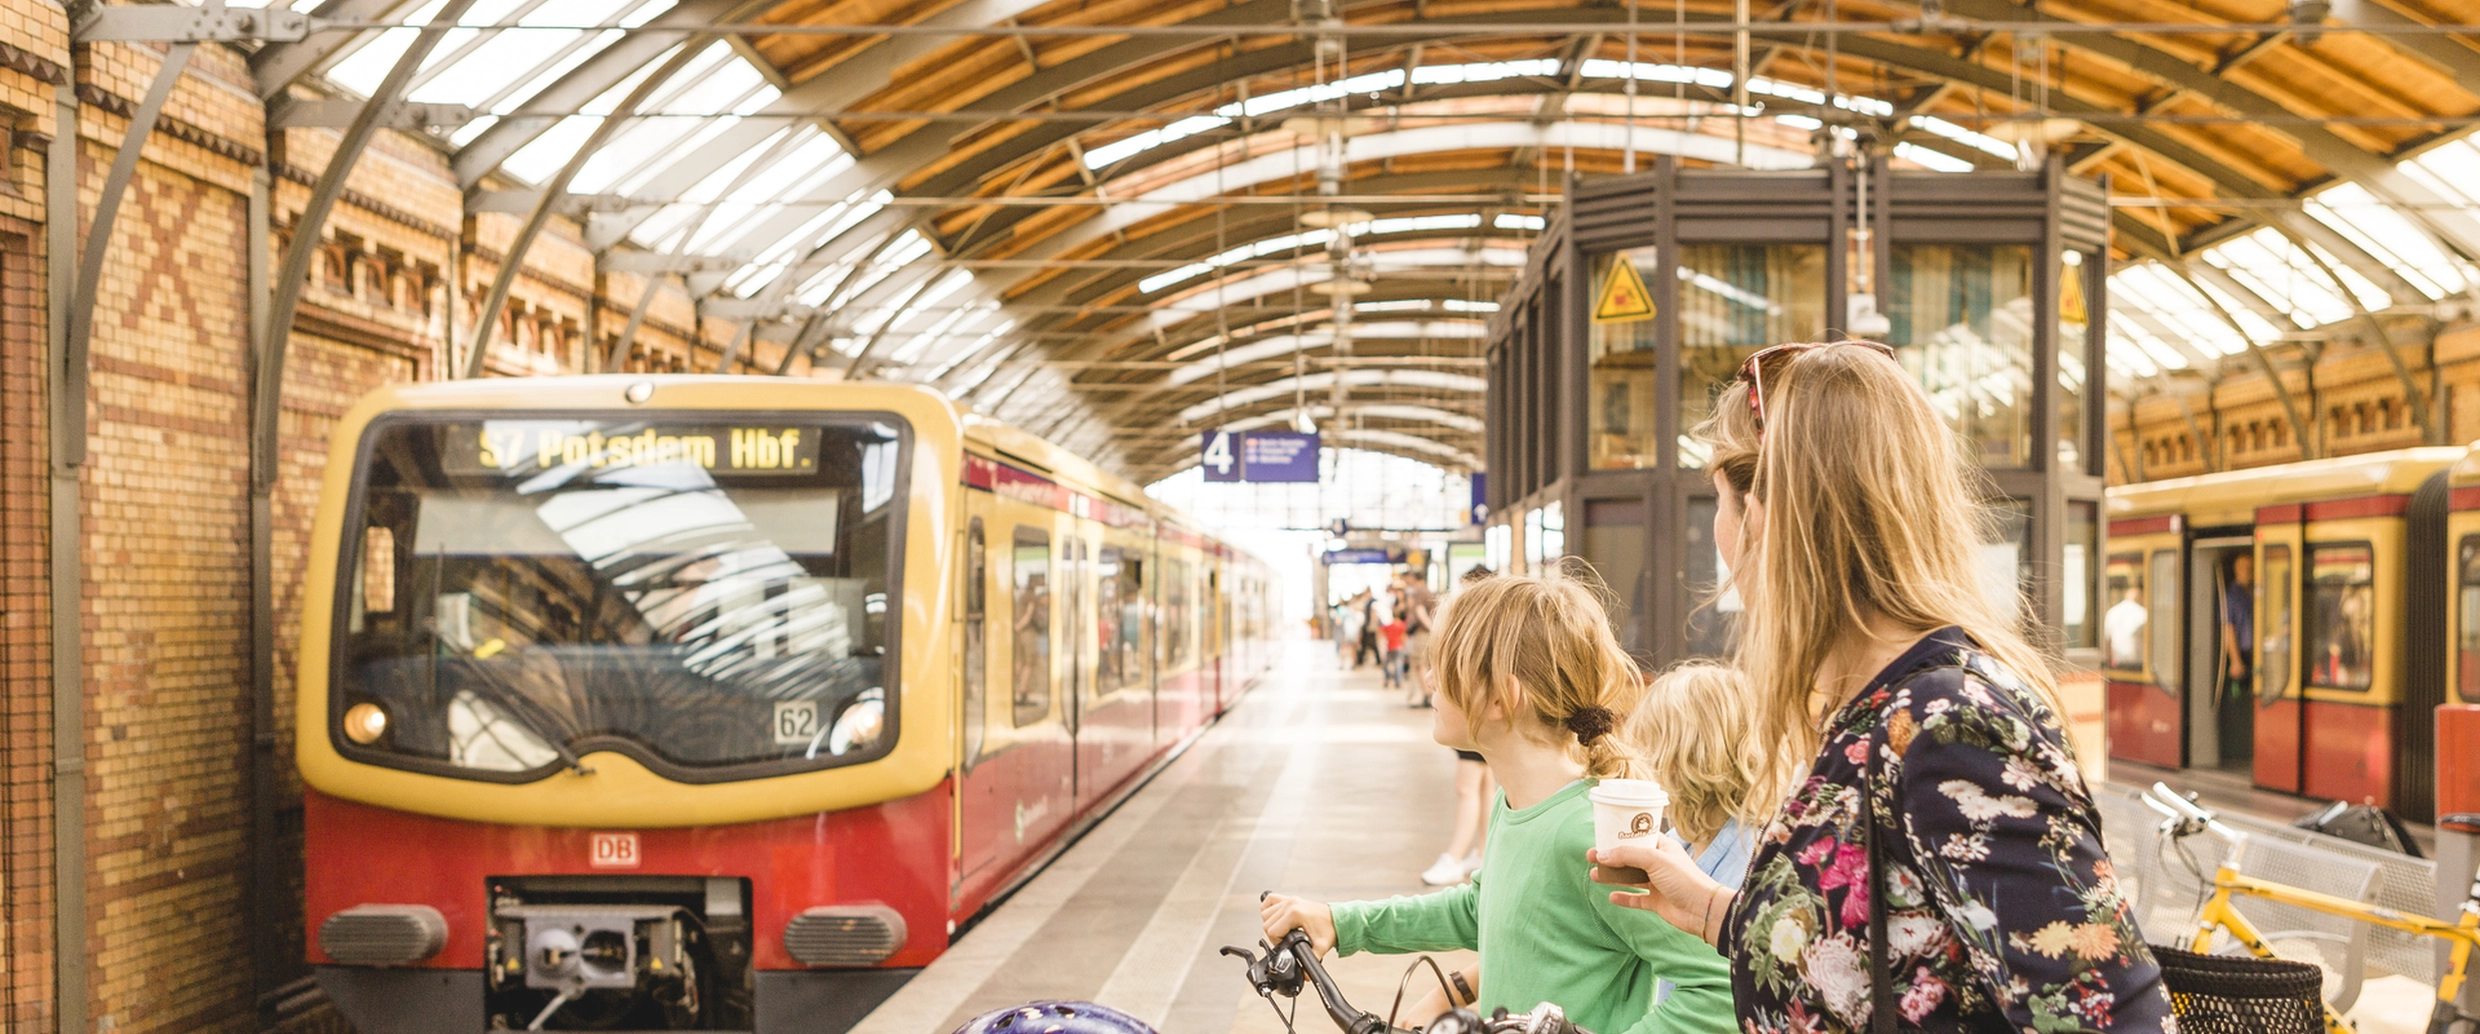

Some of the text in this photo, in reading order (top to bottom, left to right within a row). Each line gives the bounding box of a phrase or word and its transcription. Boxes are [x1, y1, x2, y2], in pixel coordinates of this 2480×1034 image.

[478, 428, 525, 468] S7
[731, 428, 812, 468] Hbf.
[1202, 430, 1235, 475] 4
[780, 708, 813, 737] 62
[598, 839, 632, 859] DB
